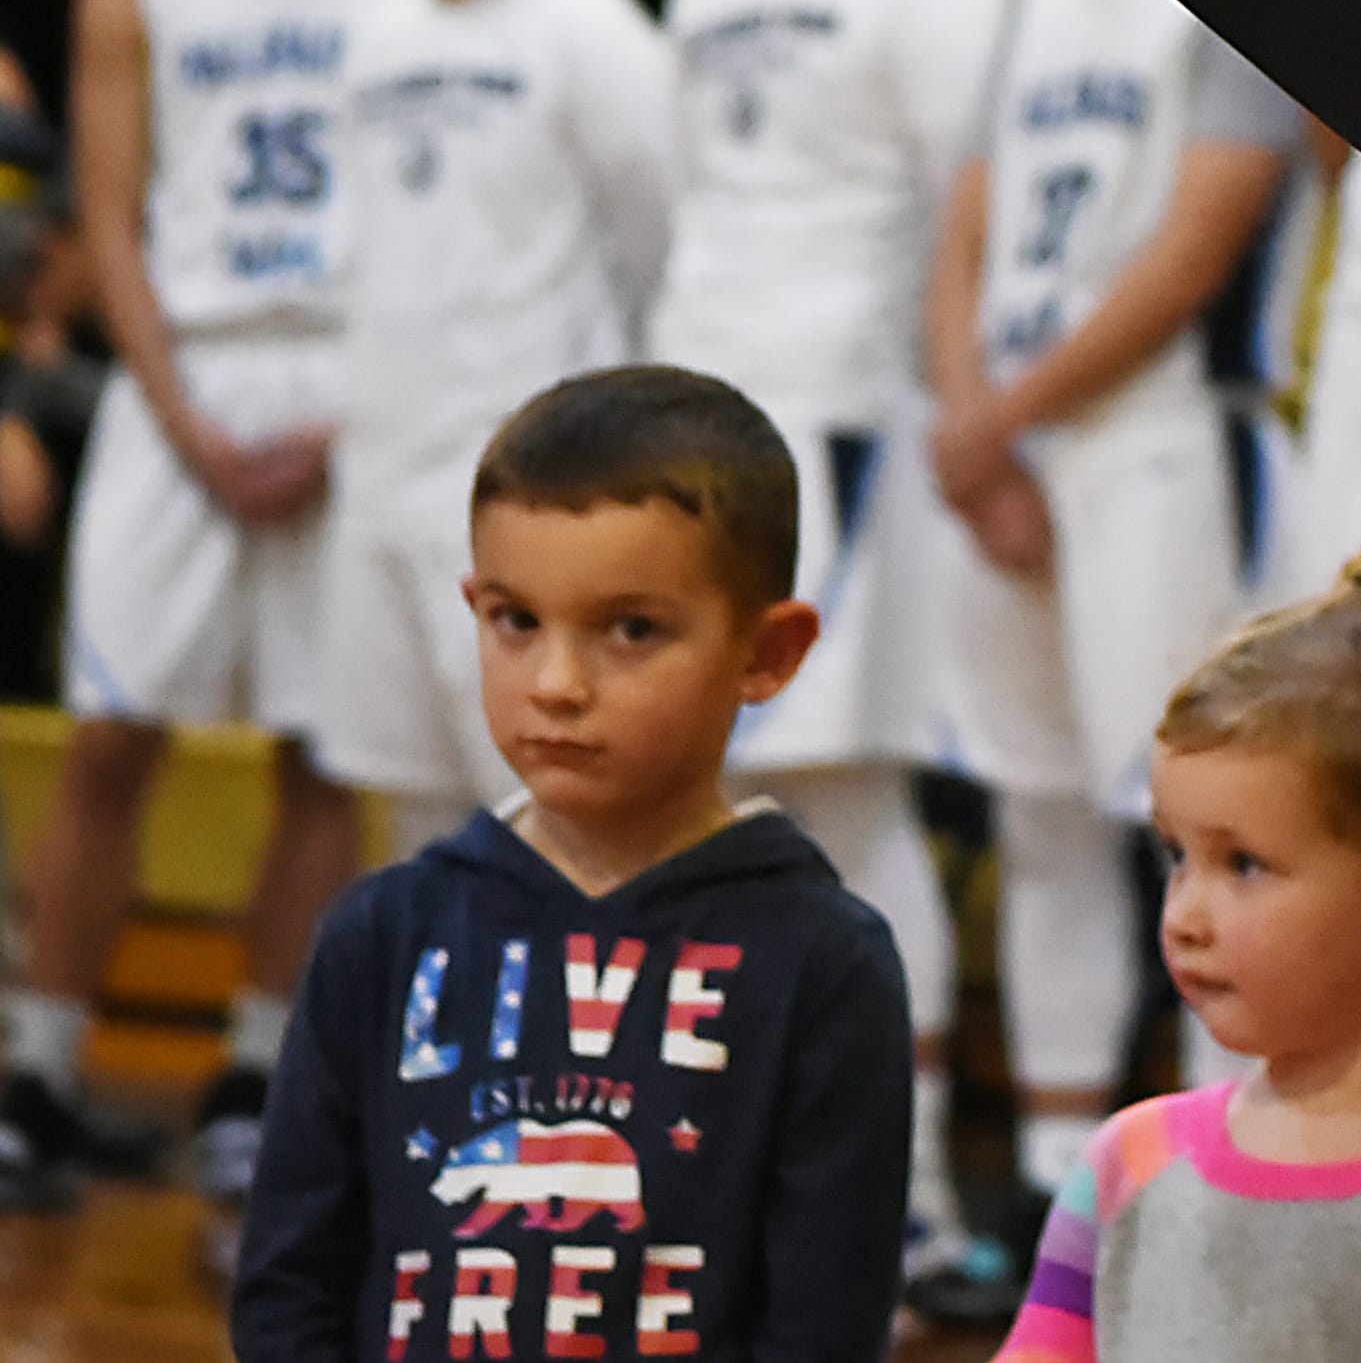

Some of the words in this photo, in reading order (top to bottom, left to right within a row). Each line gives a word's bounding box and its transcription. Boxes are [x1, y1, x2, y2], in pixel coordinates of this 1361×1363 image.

[399, 934, 744, 1082] LIVE
[470, 1075, 546, 1123] EST.
[554, 1073, 636, 1120] 1776
[387, 1245, 707, 1361] FREE
